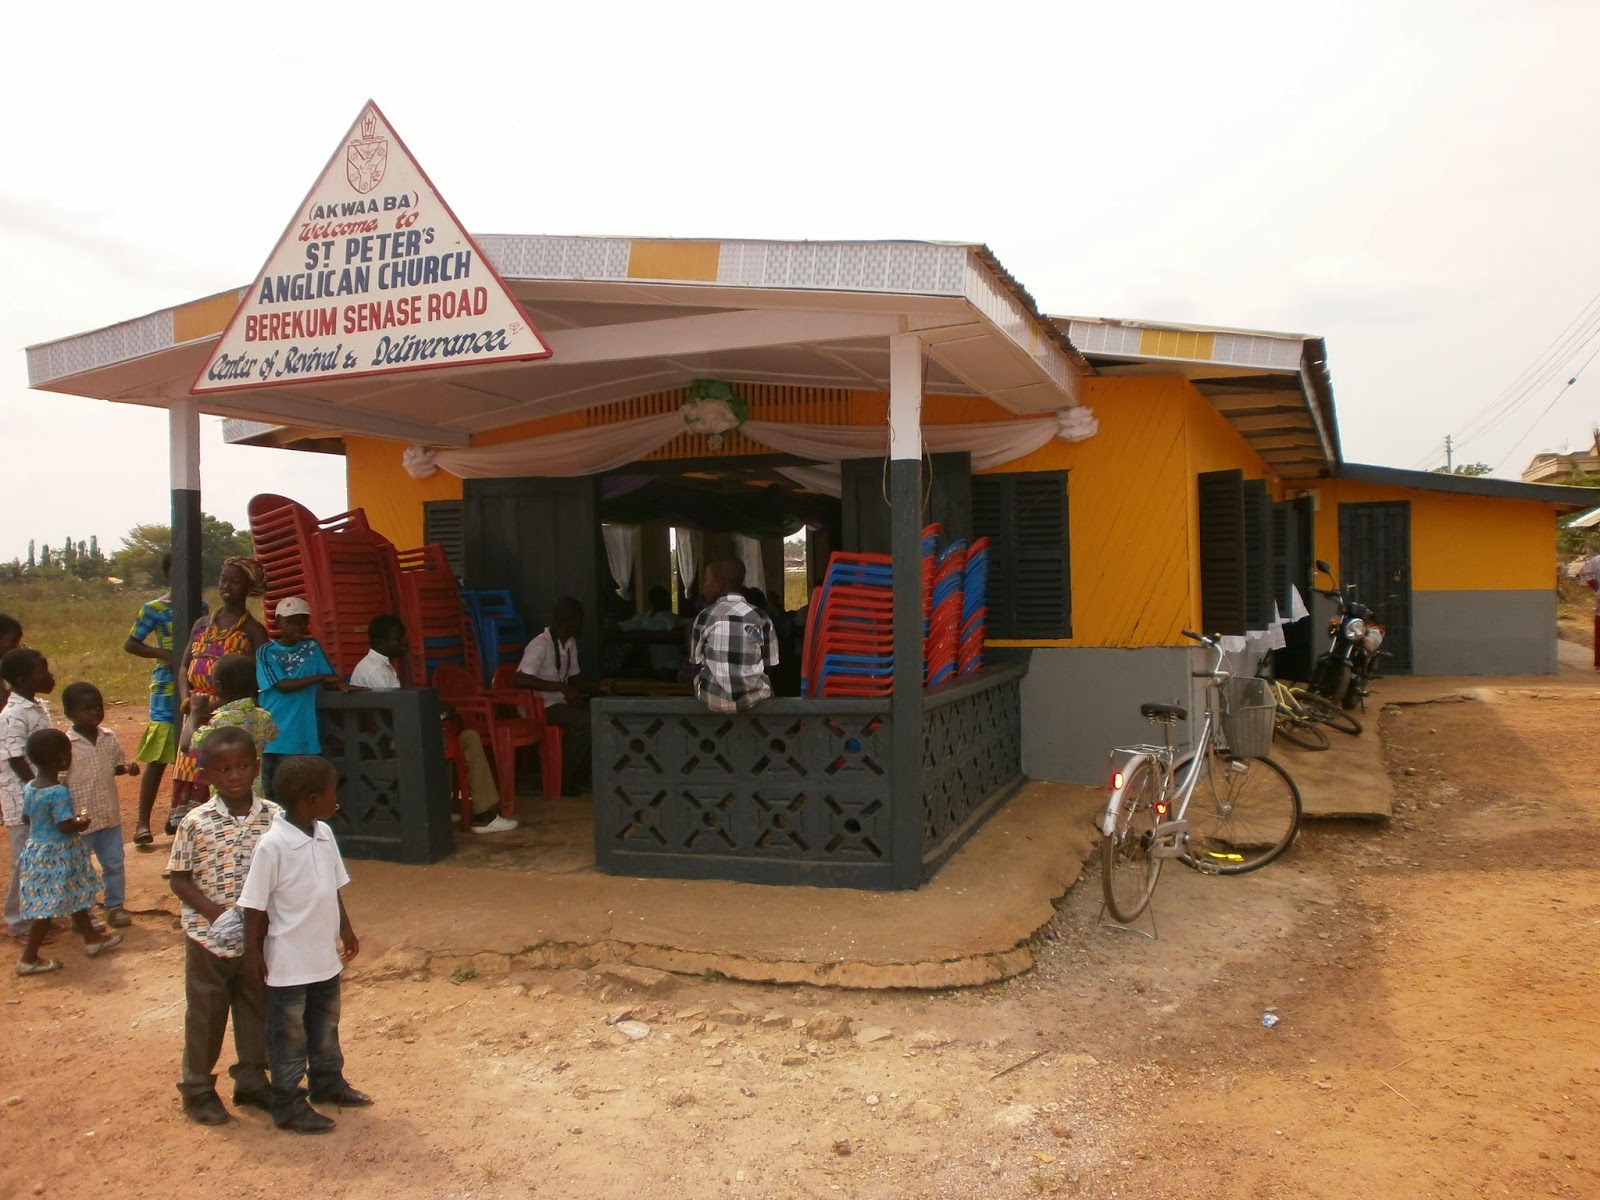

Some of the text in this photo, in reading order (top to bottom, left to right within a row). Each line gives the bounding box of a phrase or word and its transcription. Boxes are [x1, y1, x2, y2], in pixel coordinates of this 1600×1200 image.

[298, 210, 420, 241] Welcome to
[345, 227, 435, 265] PETER'S
[258, 250, 471, 304] ANGLICAN CHURCH
[245, 286, 488, 342] BEREKUM SENASE ROAD
[208, 351, 257, 381] Center
[259, 350, 280, 381] of
[275, 343, 343, 377] Revival
[371, 329, 512, 366] Deliverance
